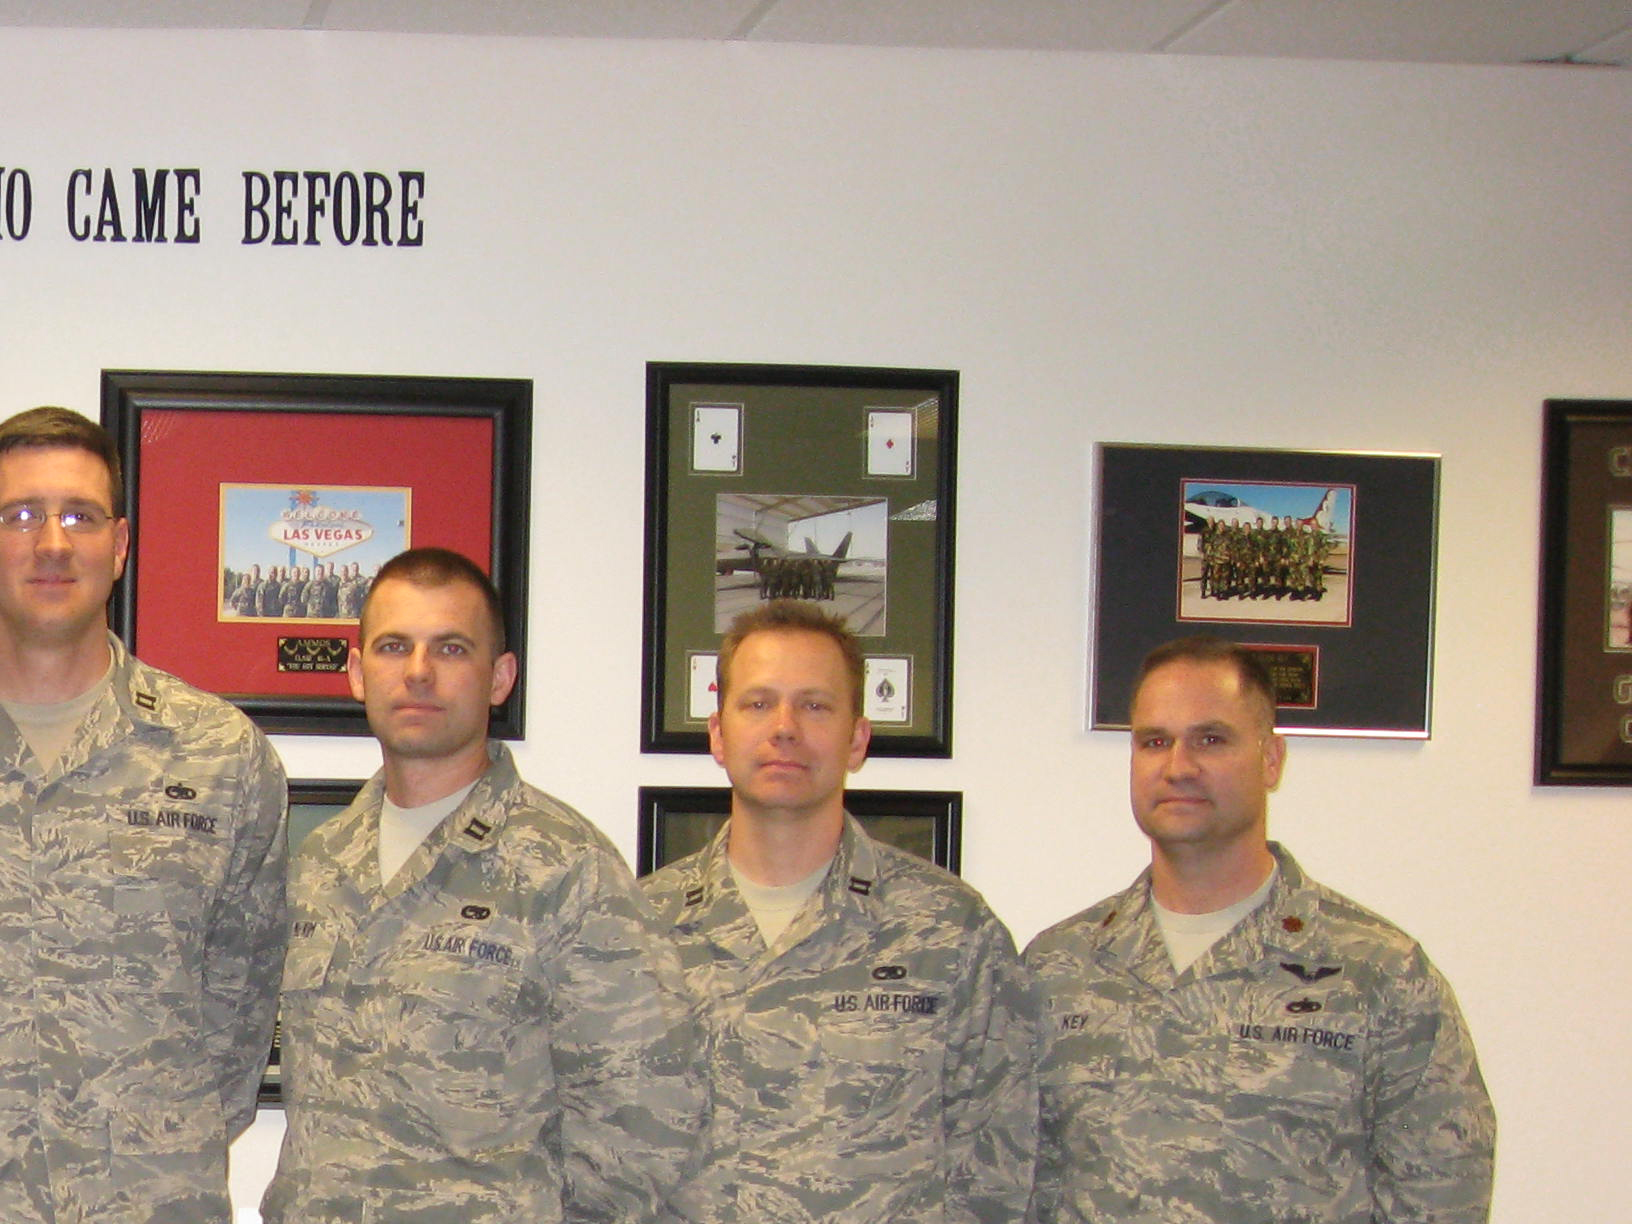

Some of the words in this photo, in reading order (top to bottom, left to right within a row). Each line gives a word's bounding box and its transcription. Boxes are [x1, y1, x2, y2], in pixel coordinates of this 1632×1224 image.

[67, 168, 200, 243] CAME
[241, 171, 425, 246] BEFORE
[283, 529, 310, 540] LAS
[314, 529, 363, 540] VEGAS
[156, 811, 180, 828] AIR
[183, 812, 218, 835] FORCE
[469, 939, 513, 965] FORCE
[864, 993, 890, 1012] AIR
[1061, 1014, 1089, 1031] KEY
[1272, 1026, 1298, 1043] AIR
[1302, 1028, 1355, 1050] FORCE
